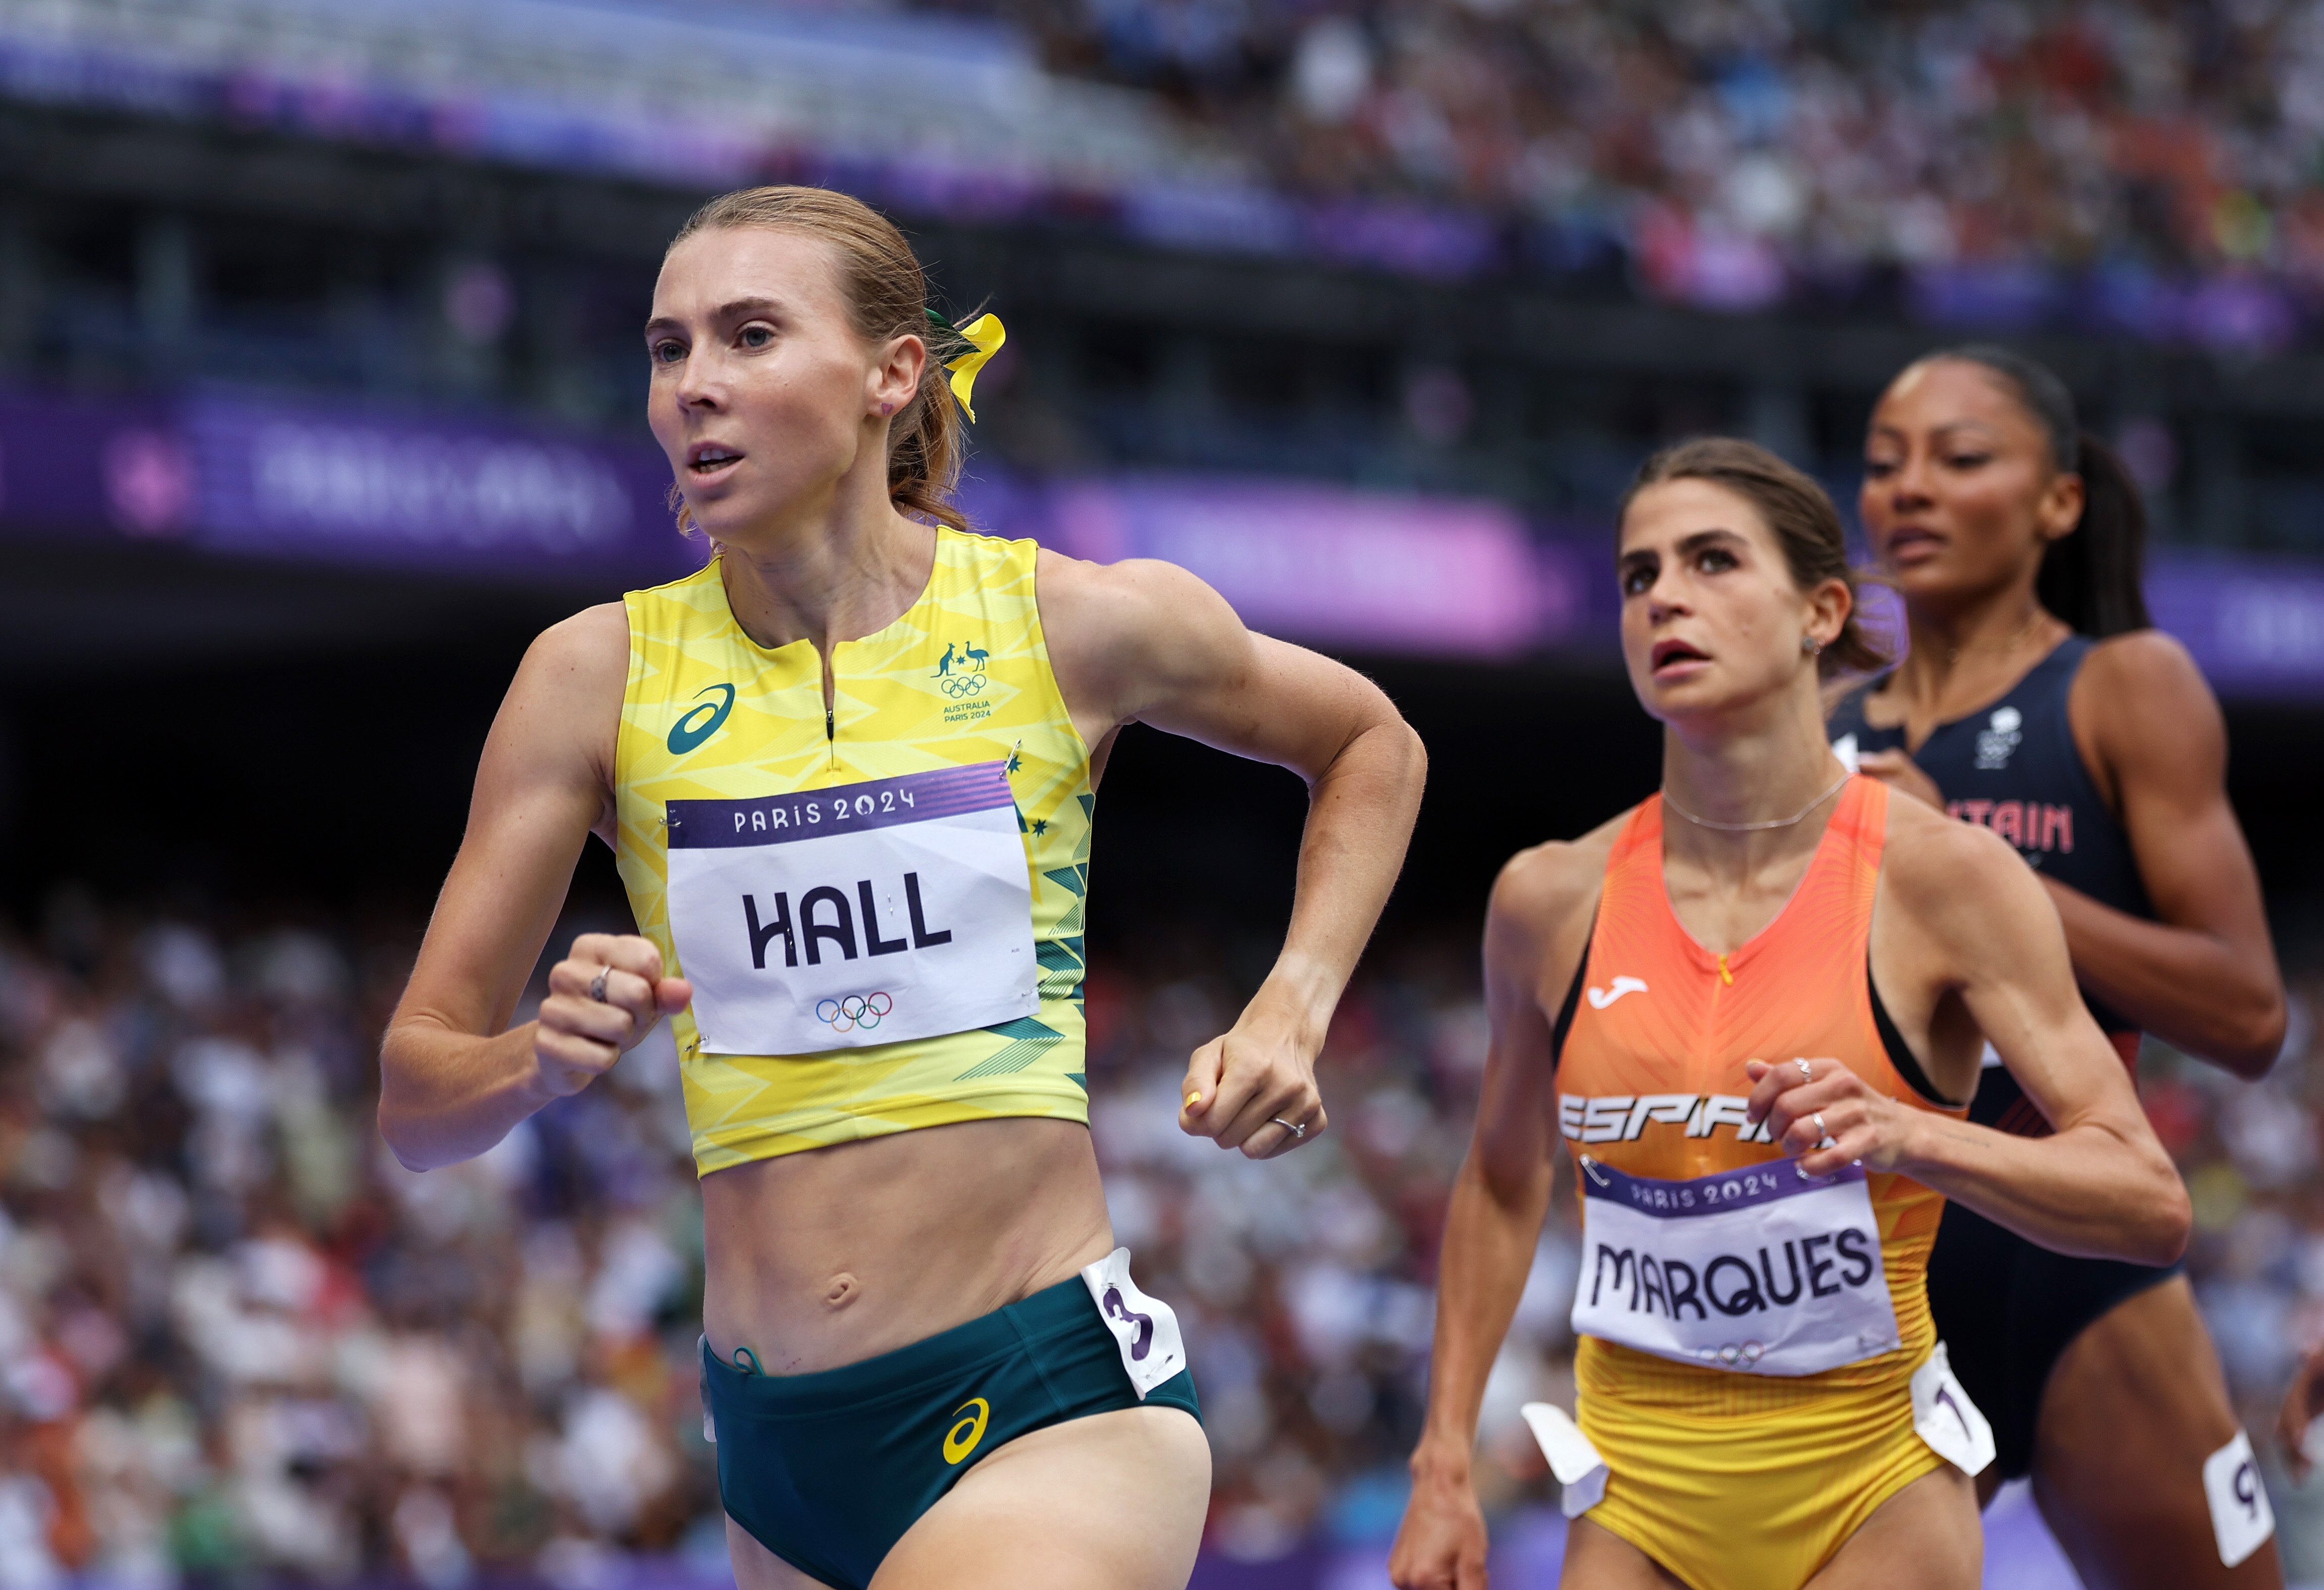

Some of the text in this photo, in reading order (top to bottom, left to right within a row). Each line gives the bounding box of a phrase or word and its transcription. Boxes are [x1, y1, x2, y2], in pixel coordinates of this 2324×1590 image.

[944, 701, 990, 713] AUSTRALIA
[945, 710, 991, 722] PARIS 2024
[834, 789, 914, 820] 2024
[1945, 797, 2074, 854] TAIN
[742, 872, 952, 969] HALL
[1559, 1093, 1838, 1149] ESPA
[1703, 1172, 1778, 1205] 2024
[1591, 1228, 1874, 1321] MARQUES
[1103, 1287, 1153, 1361] 3
